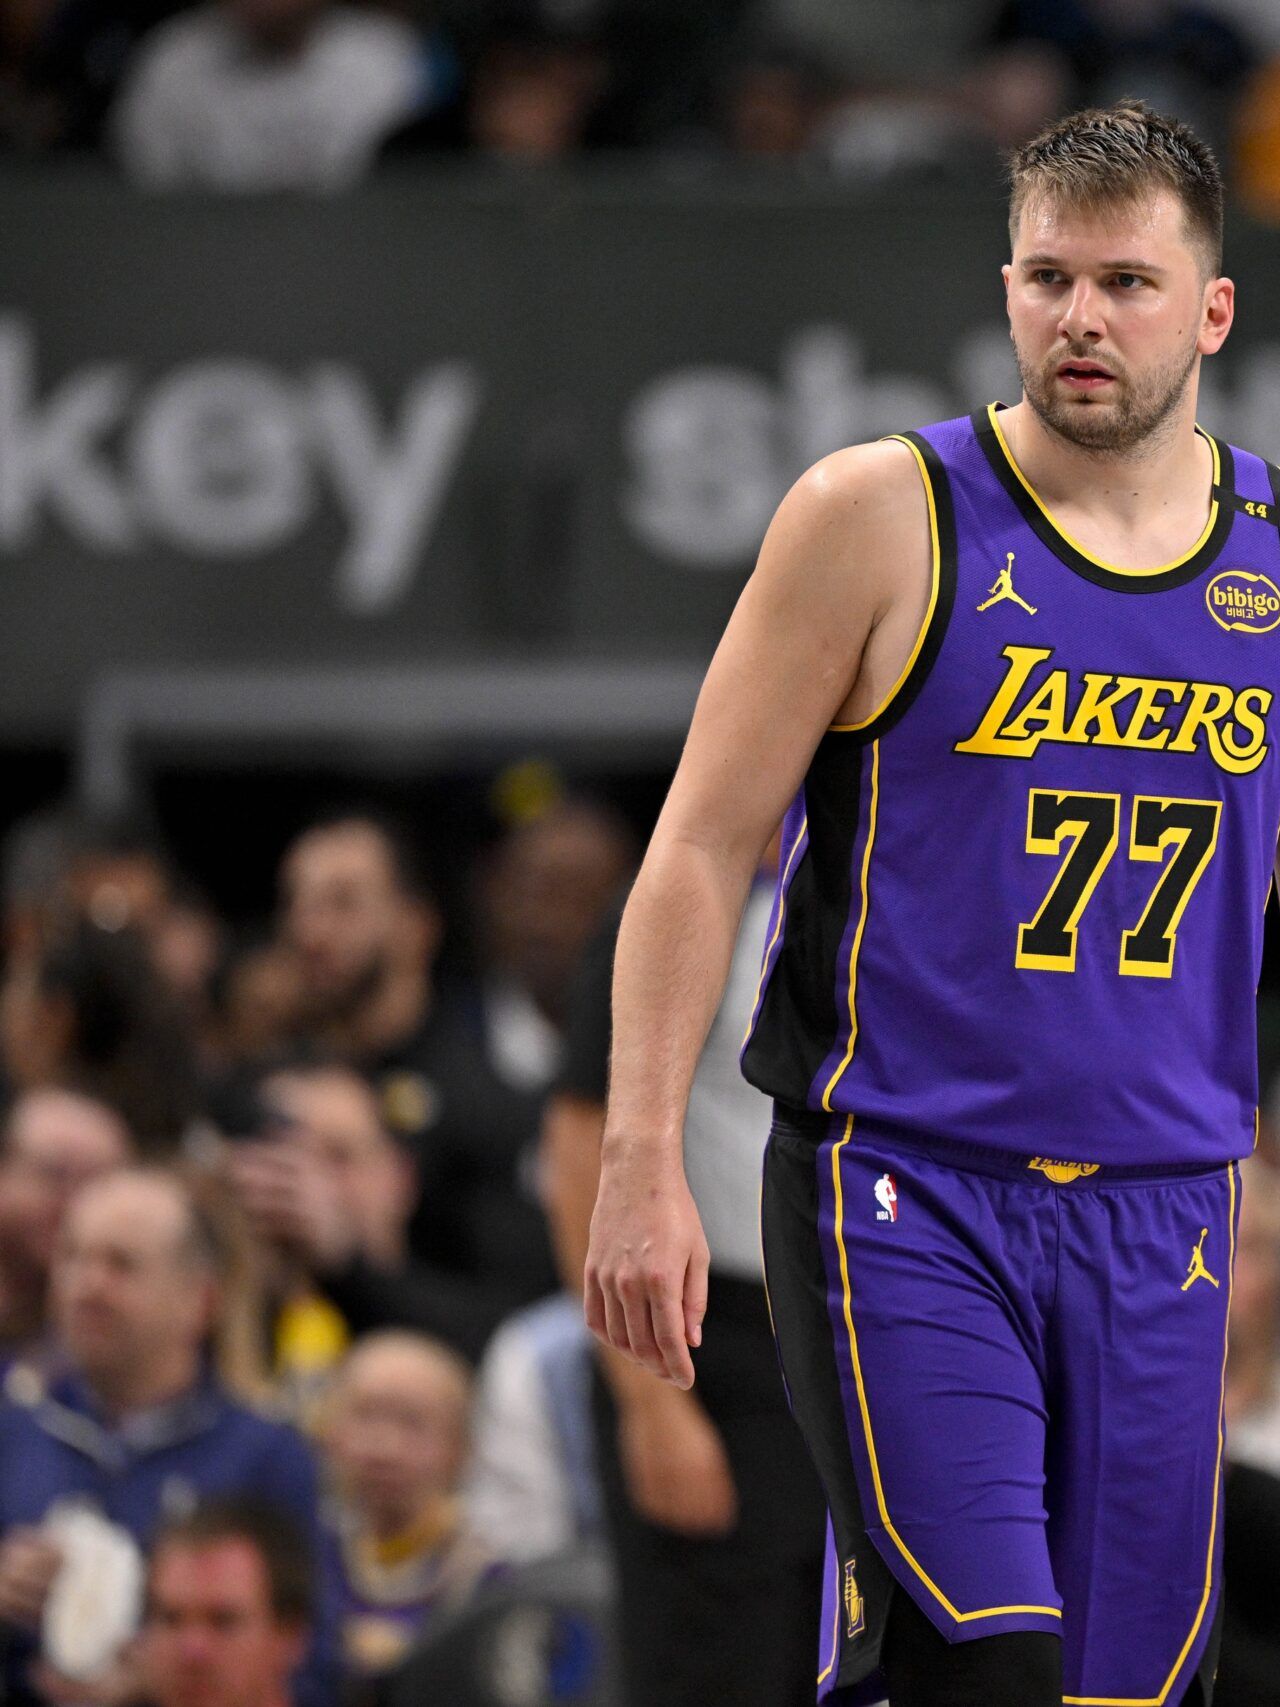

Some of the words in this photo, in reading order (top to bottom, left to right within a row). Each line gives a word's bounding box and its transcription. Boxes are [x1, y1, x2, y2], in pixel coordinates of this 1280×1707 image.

[1245, 502, 1267, 518] 44
[1213, 586, 1280, 616] bibigo
[953, 644, 1274, 775] LAKERS
[1015, 788, 1223, 979] 77
[876, 1210, 889, 1221] NBA
